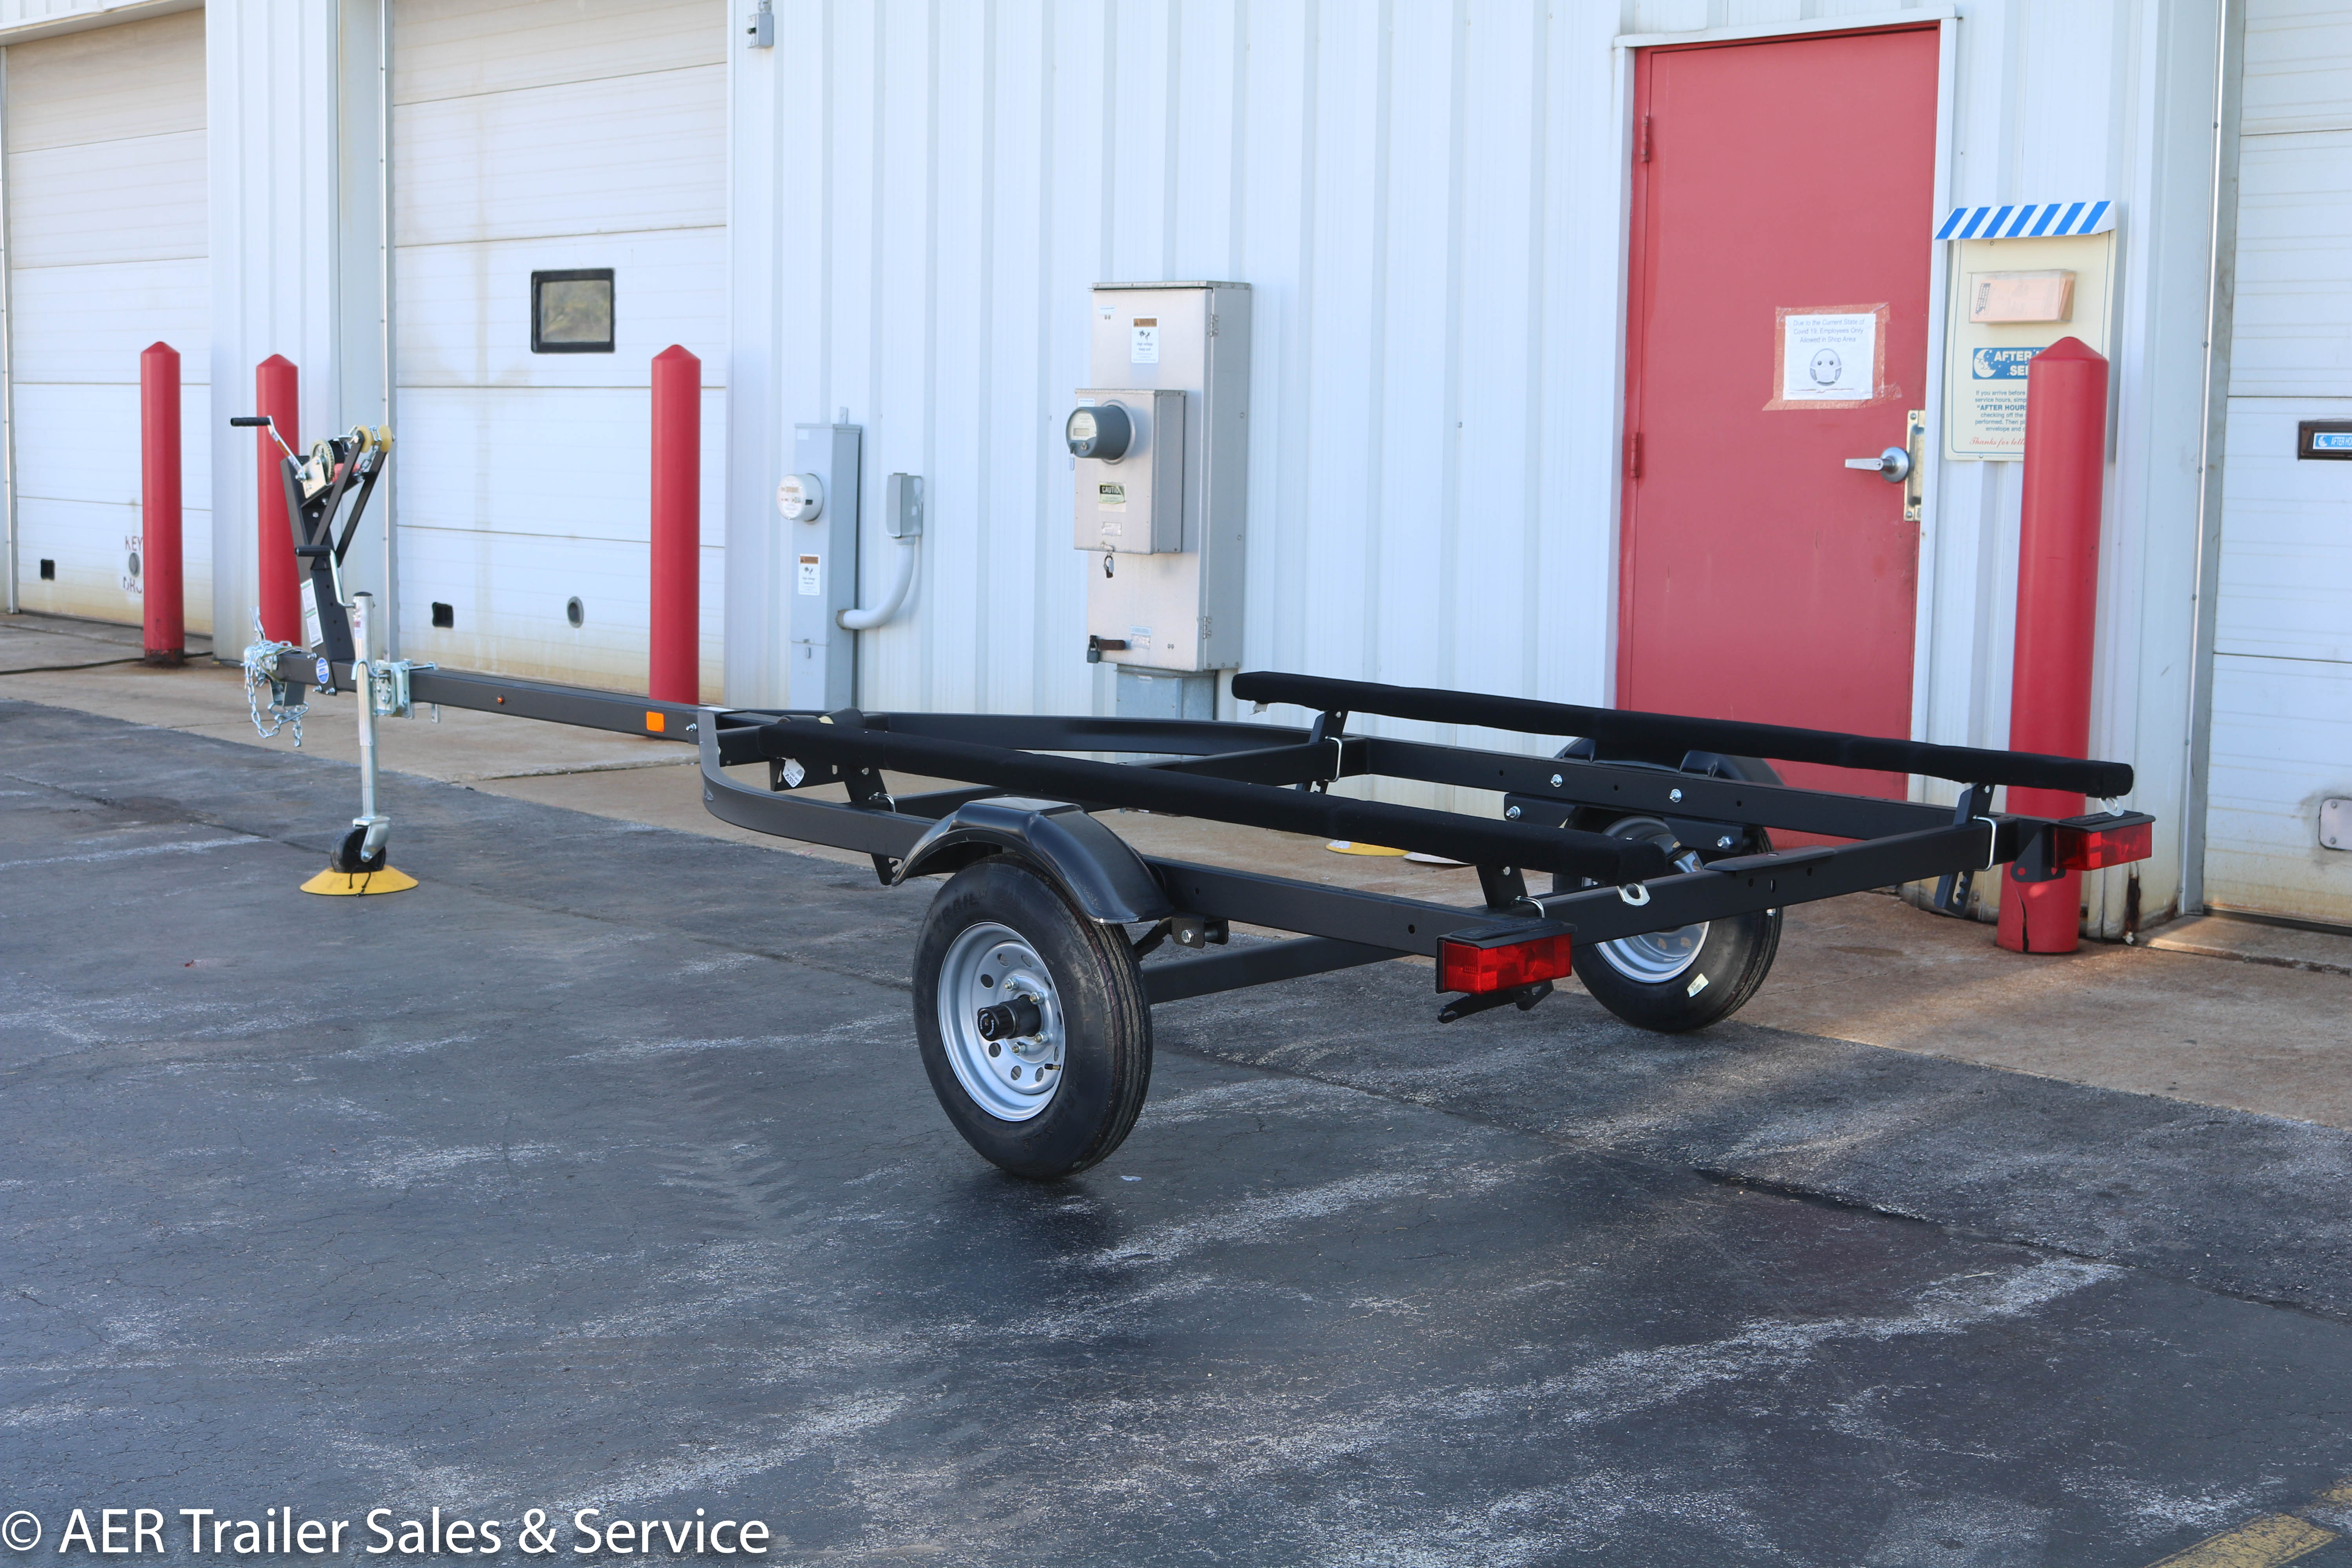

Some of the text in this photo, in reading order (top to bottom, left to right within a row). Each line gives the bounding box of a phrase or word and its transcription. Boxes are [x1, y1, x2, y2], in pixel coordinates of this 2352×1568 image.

[1994, 350, 2032, 361] AFTER
[1969, 437, 1996, 446] Thanks
[1996, 437, 2009, 449] for
[2330, 436, 2345, 446] AFTER
